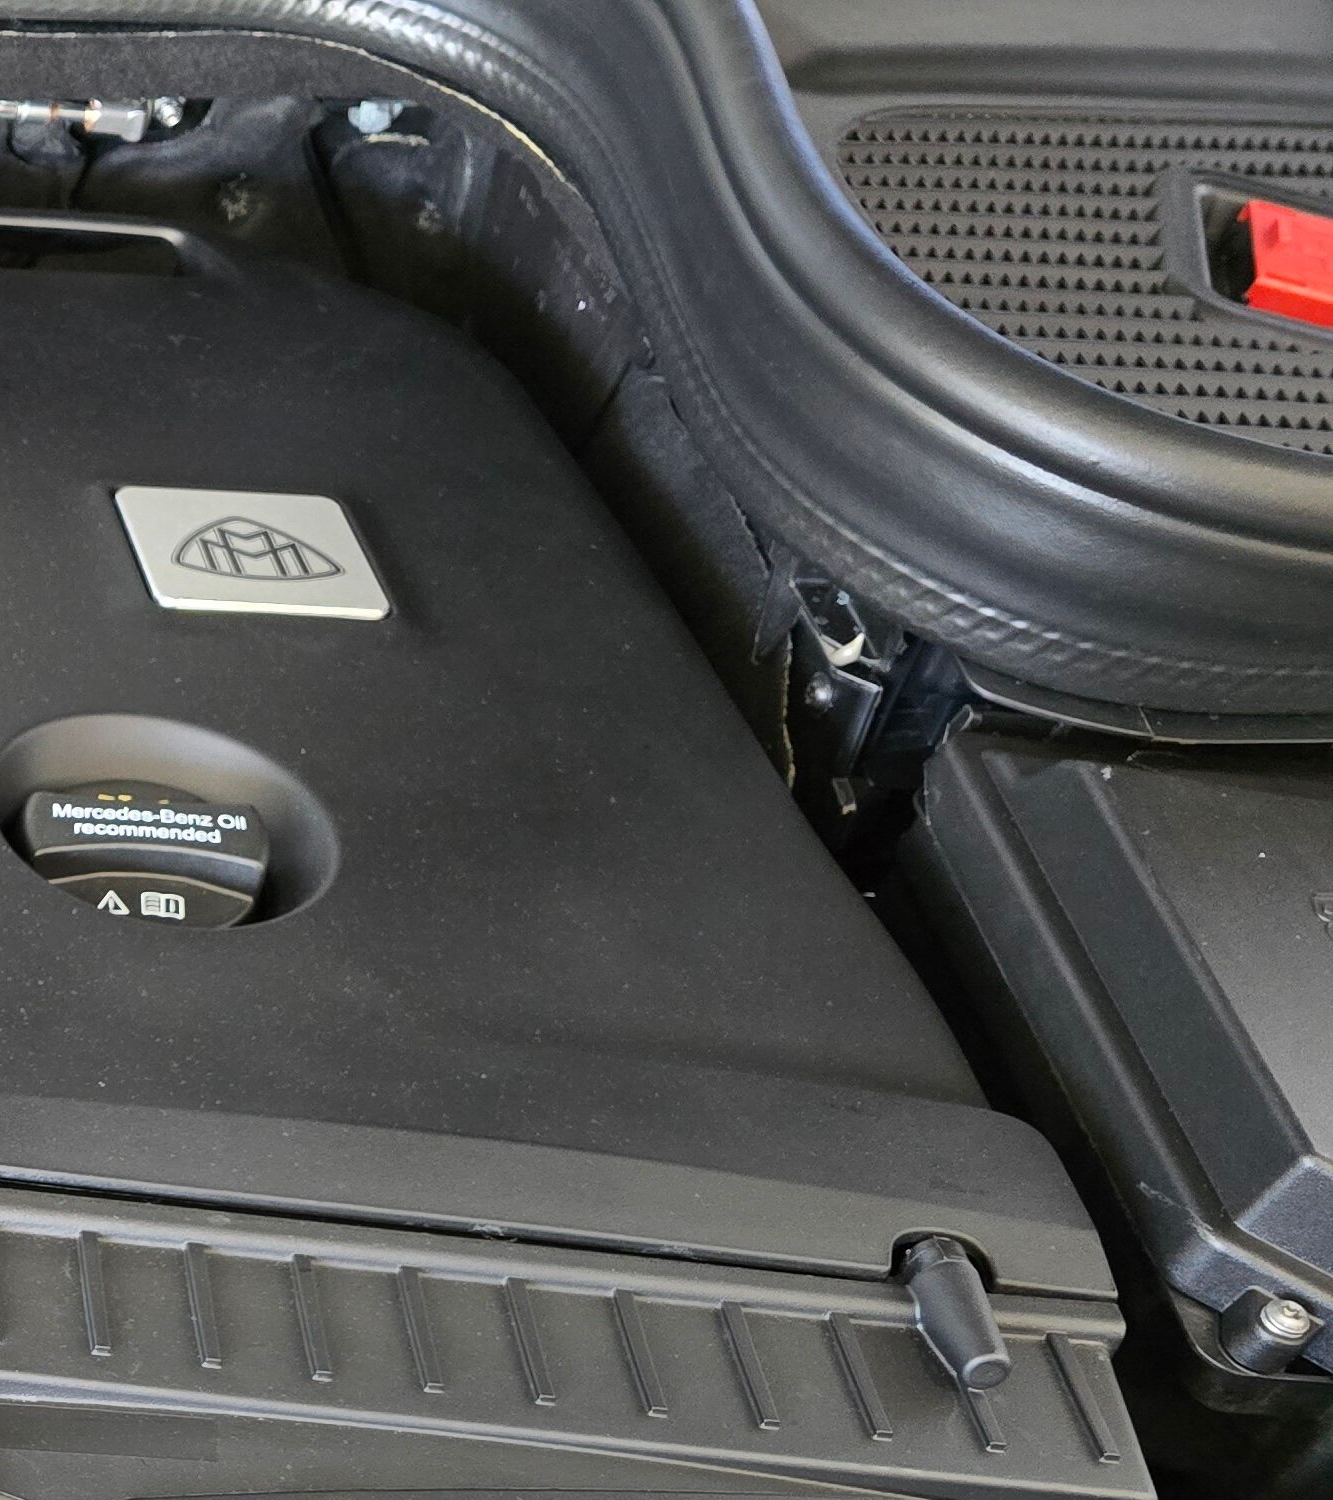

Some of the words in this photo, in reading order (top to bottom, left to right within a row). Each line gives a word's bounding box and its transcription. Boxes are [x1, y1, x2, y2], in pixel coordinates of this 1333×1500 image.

[51, 803, 214, 828] Mercedes-Benz
[216, 813, 248, 831] Oil
[73, 822, 222, 844] recommended
